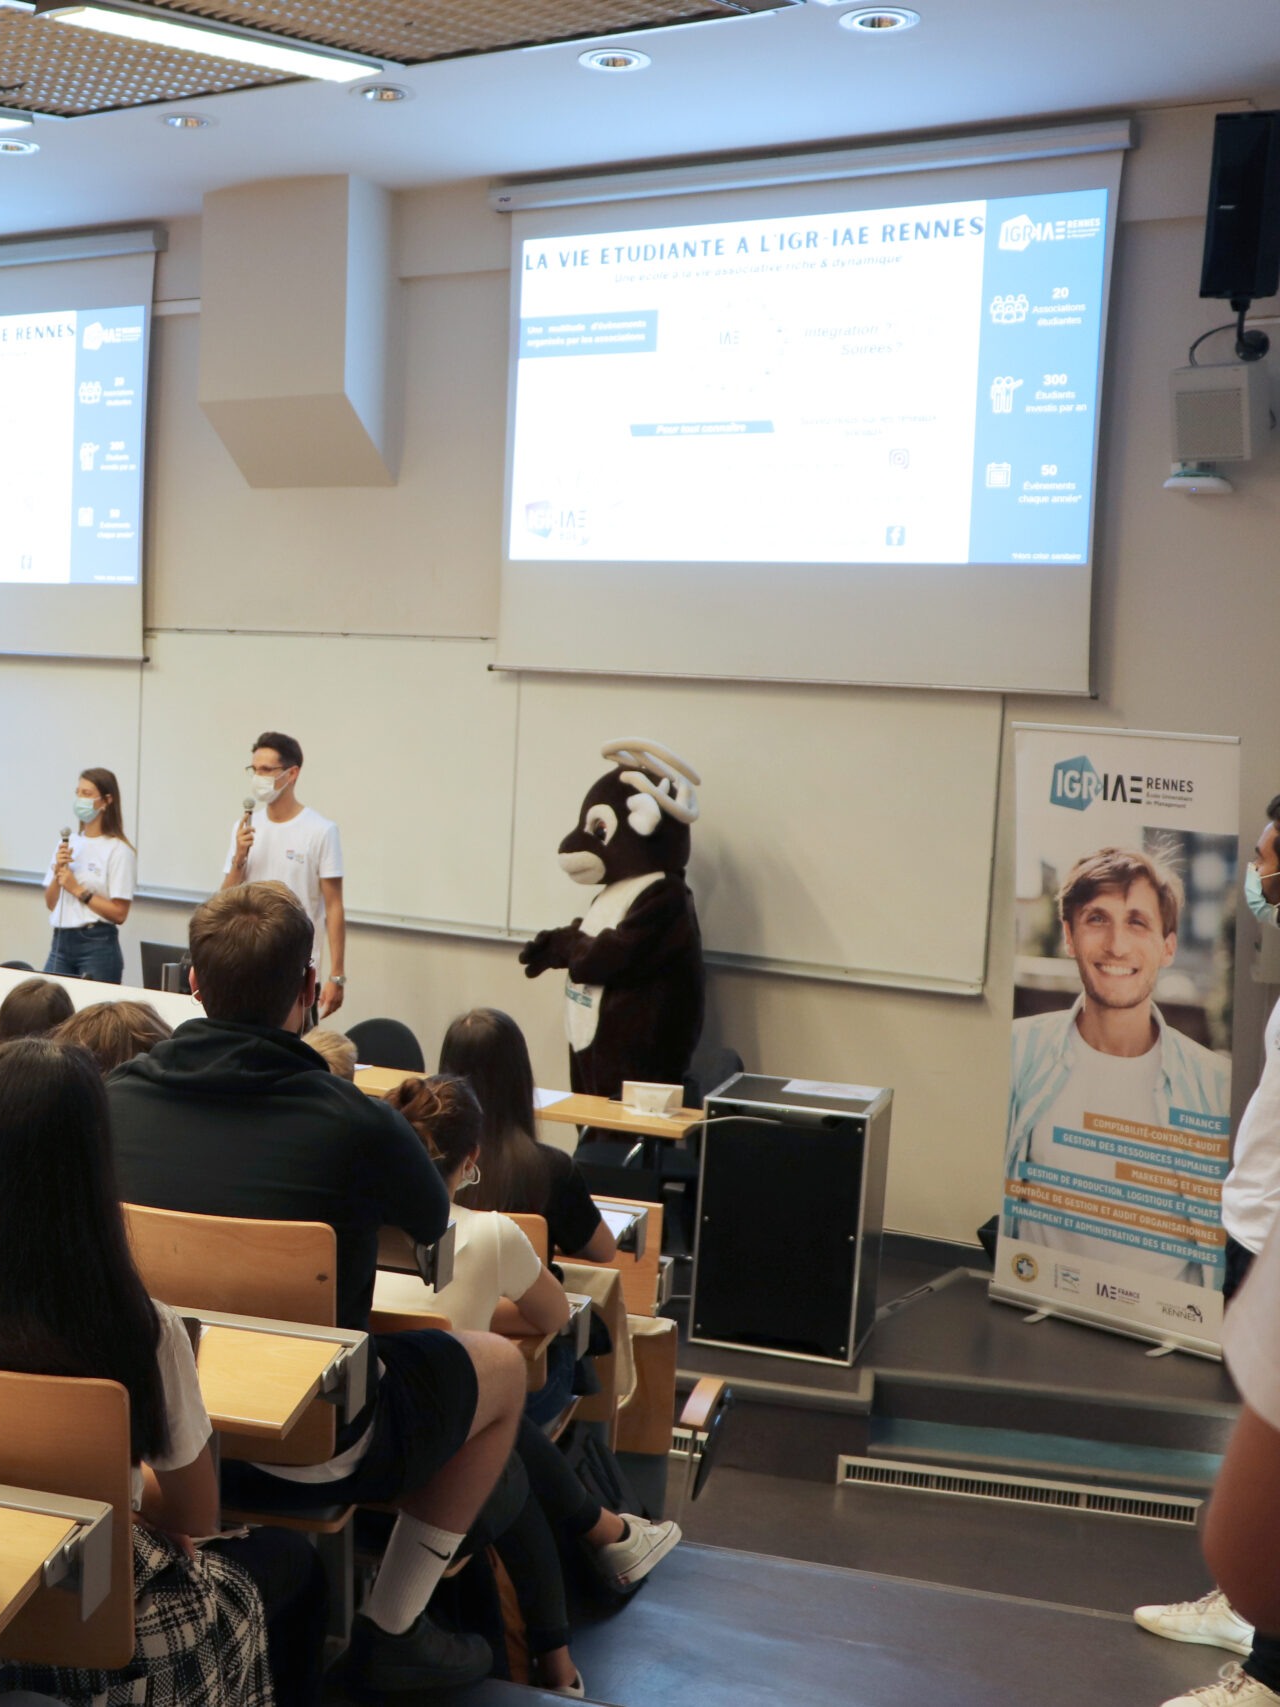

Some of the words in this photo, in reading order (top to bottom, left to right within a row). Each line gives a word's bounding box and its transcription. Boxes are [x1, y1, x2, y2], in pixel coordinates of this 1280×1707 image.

[524, 253, 549, 271] LA
[558, 248, 590, 268] VIE
[599, 238, 726, 265] ETUDIANTE
[735, 236, 750, 254] A
[880, 216, 985, 244] RENNES
[1051, 287, 1070, 300] 20
[15, 323, 75, 341] RENNES
[1042, 373, 1068, 386] 300
[1040, 464, 1058, 477] 50
[1056, 768, 1098, 801] IGR
[1102, 773, 1143, 805] IAE
[1146, 776, 1195, 793] RENNES
[1179, 1114, 1222, 1131] FINANCE
[1062, 1133, 1097, 1149] GESTION
[1098, 1141, 1115, 1153] DES
[1116, 1144, 1173, 1165] RESSOURCES
[1174, 1157, 1221, 1175] HUMAINES
[1131, 1169, 1179, 1188] MARKETING
[1179, 1180, 1191, 1190] ET
[1192, 1184, 1220, 1197] VENTE
[1026, 1167, 1059, 1181] GESTION
[1060, 1175, 1071, 1184] DE
[1127, 1190, 1174, 1209] LOGISTIQUE
[1175, 1201, 1186, 1211] ET
[1187, 1204, 1219, 1219] ACHATS
[1009, 1183, 1050, 1201] CONTRÔLE
[1052, 1193, 1063, 1204] DE
[1064, 1197, 1100, 1213] GESTION
[1100, 1206, 1111, 1216] ET
[1112, 1209, 1138, 1222] AUDIT
[1139, 1214, 1218, 1241] ORGANISATIONNEL
[1011, 1205, 1063, 1224] MANAGEMENT
[1064, 1217, 1074, 1228] ET
[1075, 1221, 1141, 1244] ADMINISTRATION
[1142, 1237, 1159, 1249] DES
[1161, 1241, 1218, 1263] ENTREPRISES
[1096, 1282, 1117, 1300] IAE
[1161, 1305, 1197, 1322] RENNES
